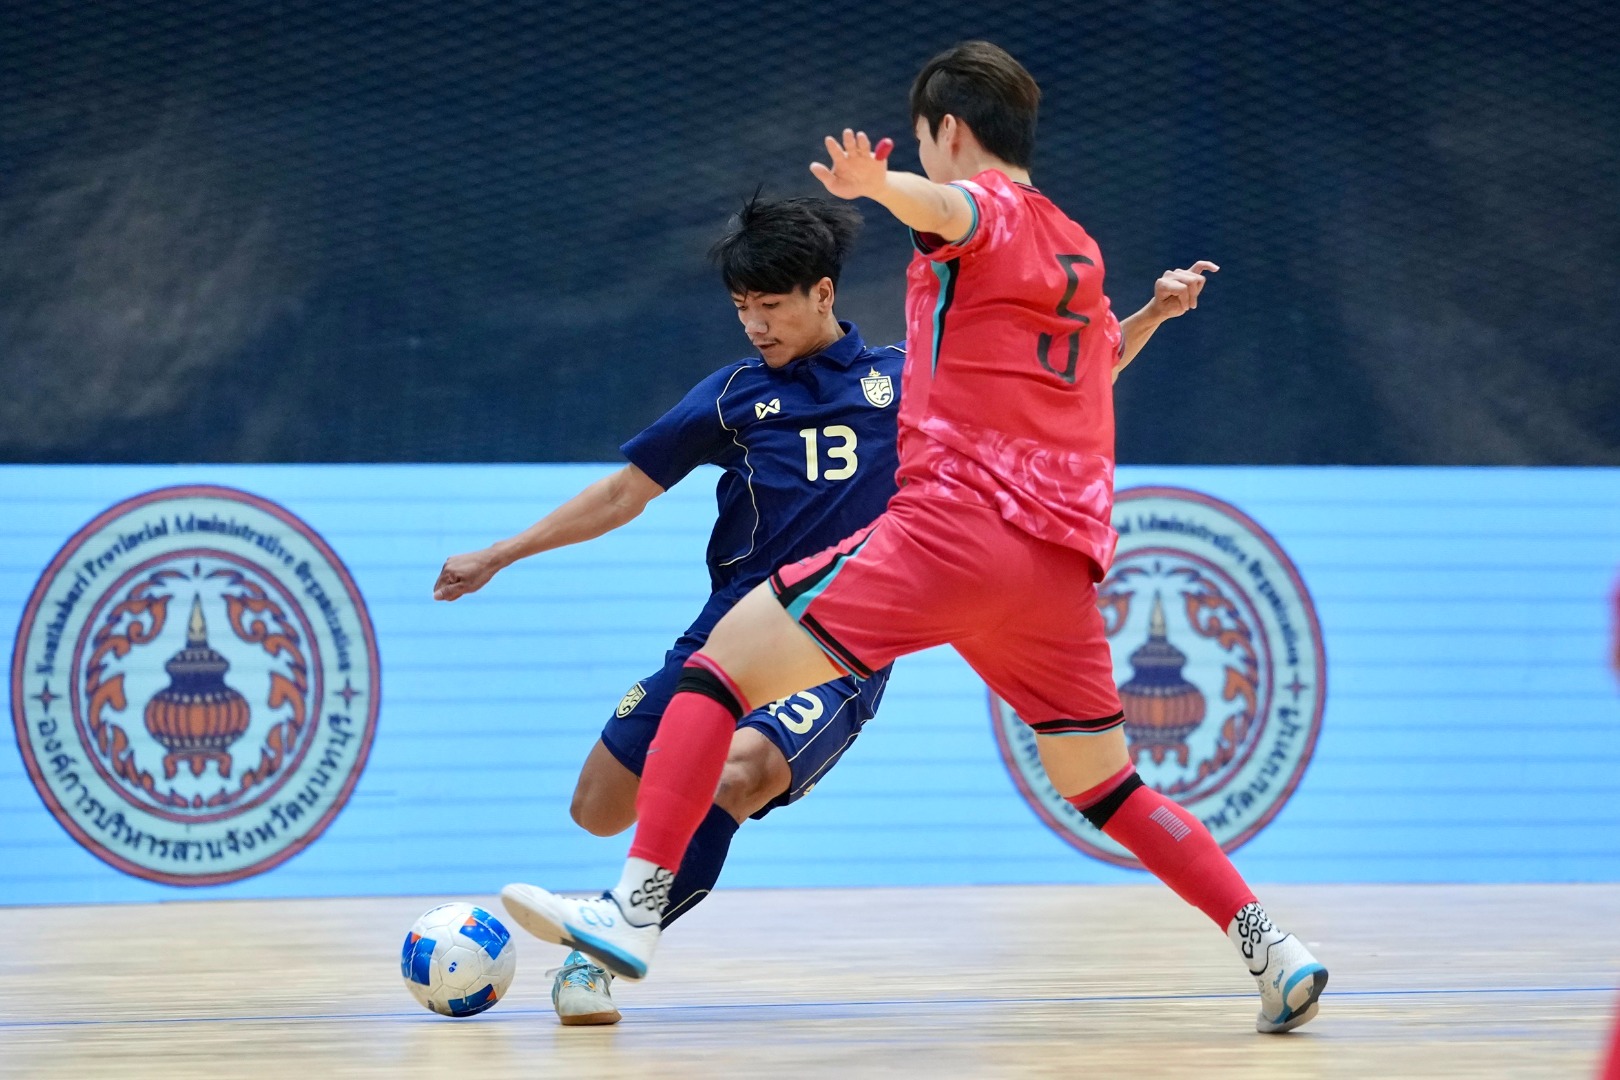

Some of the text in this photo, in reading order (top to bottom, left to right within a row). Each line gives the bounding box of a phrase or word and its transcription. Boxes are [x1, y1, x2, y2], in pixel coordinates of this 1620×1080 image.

[1037, 253, 1095, 384] 5
[799, 424, 858, 482] 13
[83, 515, 169, 579] Provincial
